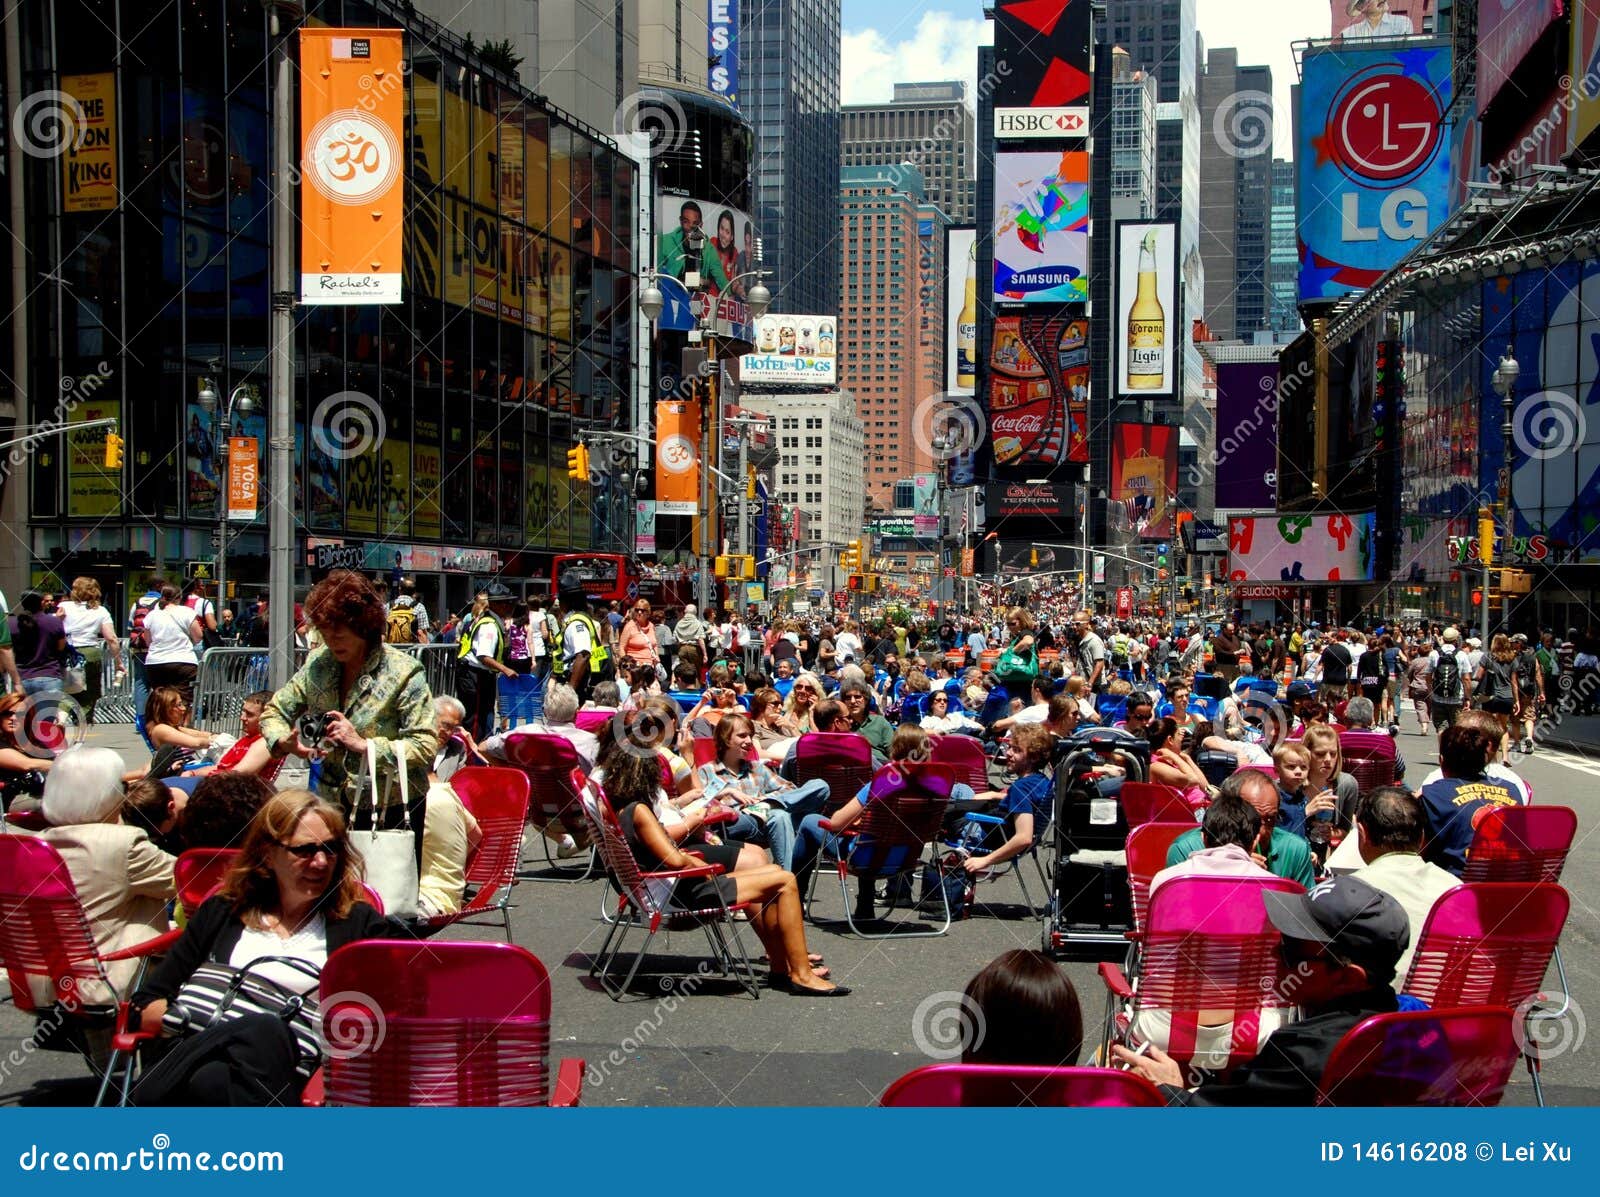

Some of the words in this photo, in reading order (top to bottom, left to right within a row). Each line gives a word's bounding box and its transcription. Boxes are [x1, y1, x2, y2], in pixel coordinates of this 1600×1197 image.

[1000, 115, 1053, 131] HSBC
[69, 162, 113, 194] KING
[1341, 188, 1429, 242] LG
[319, 275, 381, 290] Rachel's
[1011, 273, 1071, 285] SAMSUNG
[960, 324, 976, 334] Cor
[745, 355, 787, 370] HOTEL
[1132, 348, 1161, 364] Light
[242, 464, 255, 499] YOGA
[1007, 485, 1054, 497] GMC
[1241, 585, 1281, 597] swatch
